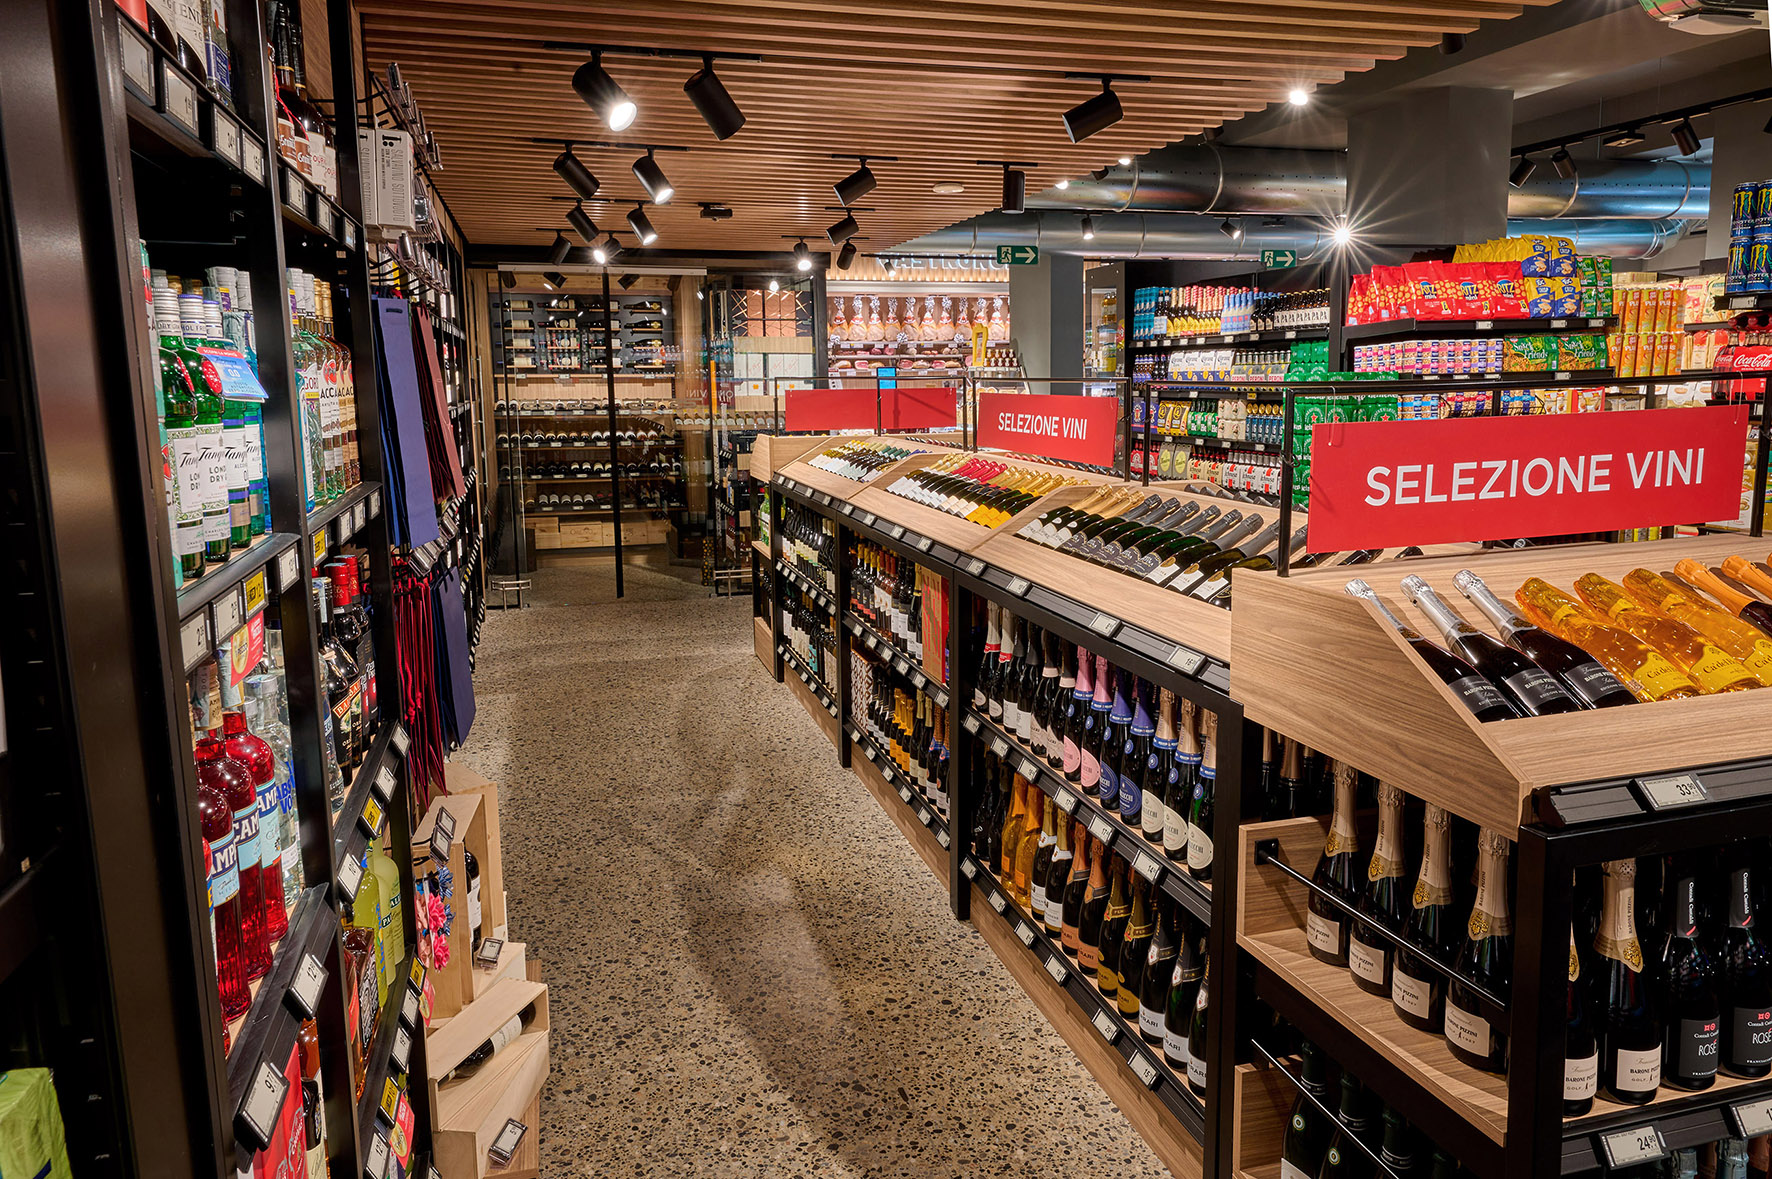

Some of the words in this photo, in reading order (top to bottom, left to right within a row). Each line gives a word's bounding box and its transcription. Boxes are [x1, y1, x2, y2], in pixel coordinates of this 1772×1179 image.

[1733, 353, 1772, 368] Coca-Cola
[998, 412, 1060, 437] SELEZIONE
[1062, 417, 1087, 440] VINI
[1364, 453, 1613, 507] SELEZIONE
[1627, 447, 1705, 490] VINI
[1459, 1025, 1478, 1038] PIZZINI
[1698, 1039, 1717, 1056] ROSÉ
